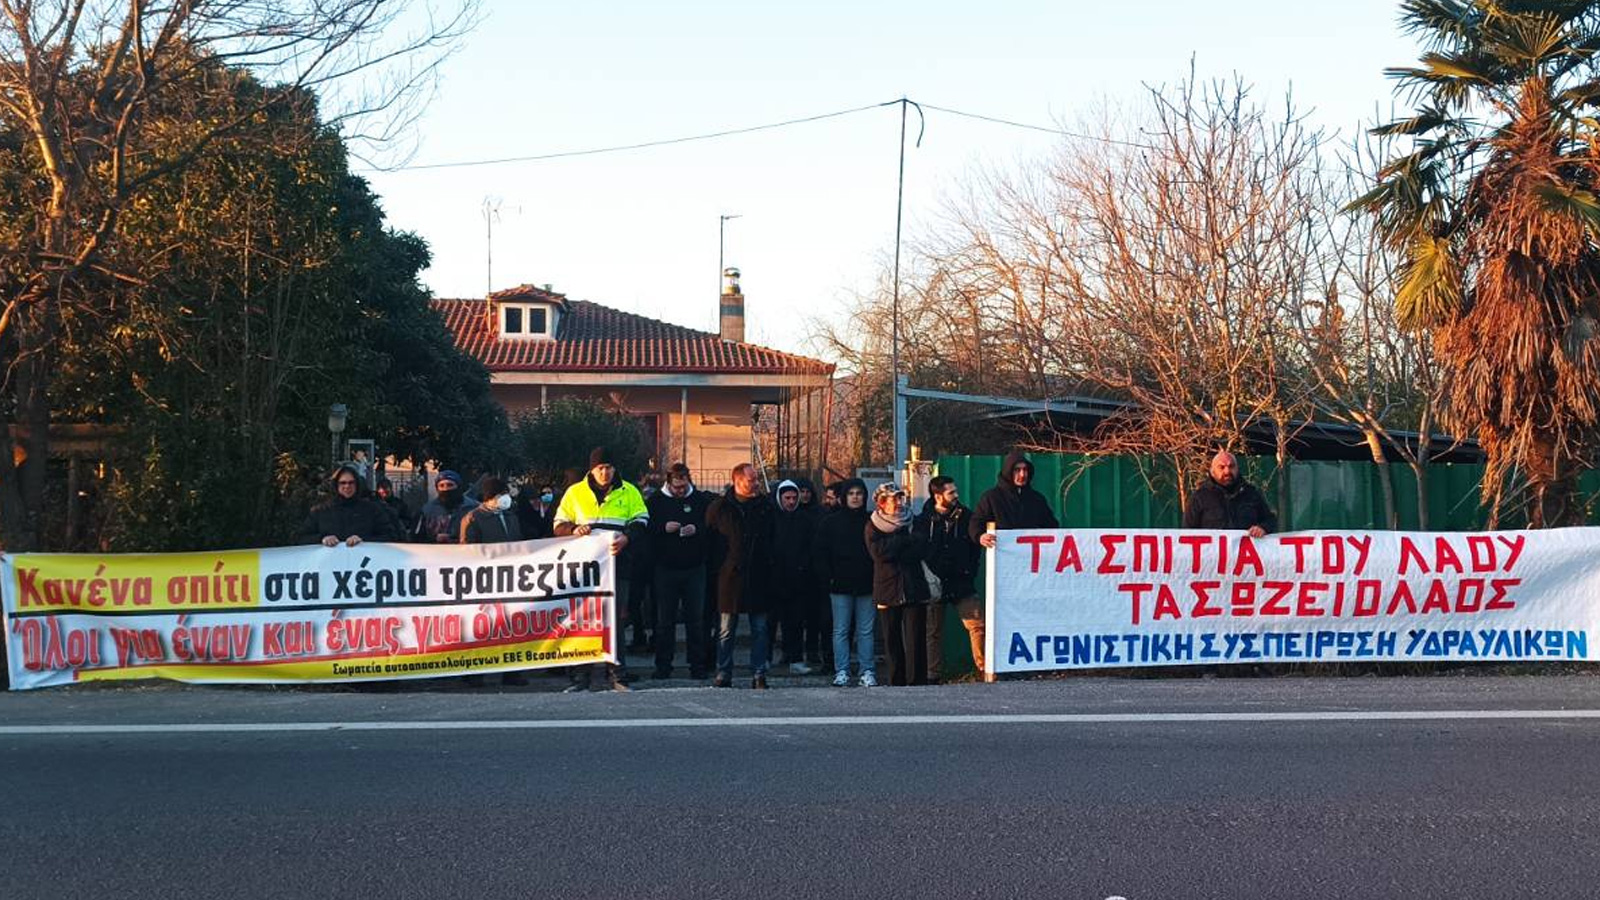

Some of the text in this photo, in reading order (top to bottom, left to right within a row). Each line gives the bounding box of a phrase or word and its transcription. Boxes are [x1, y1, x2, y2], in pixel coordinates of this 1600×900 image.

[1016, 534, 1525, 576] ΤΑ ΣΠΙΤΙΑ ΤΟΥ ΛΑΟΥ
[17, 549, 601, 607] Κανένα σπίτι στα χέρια τραπεζίτη
[12, 614, 100, 671] Όλοι
[109, 626, 166, 669] για
[170, 615, 251, 661] έναν
[263, 621, 316, 656] και
[325, 609, 401, 656] ένας
[411, 615, 462, 654] για
[503, 652, 523, 663] ΕΒΕ
[1008, 629, 1588, 665] ΑΓΩΝΙΣΤΙΚΗ ΣΥΣΠΕΙΡΩΣΗ ΥΔΡΑΥΛΙΚΩΝ
